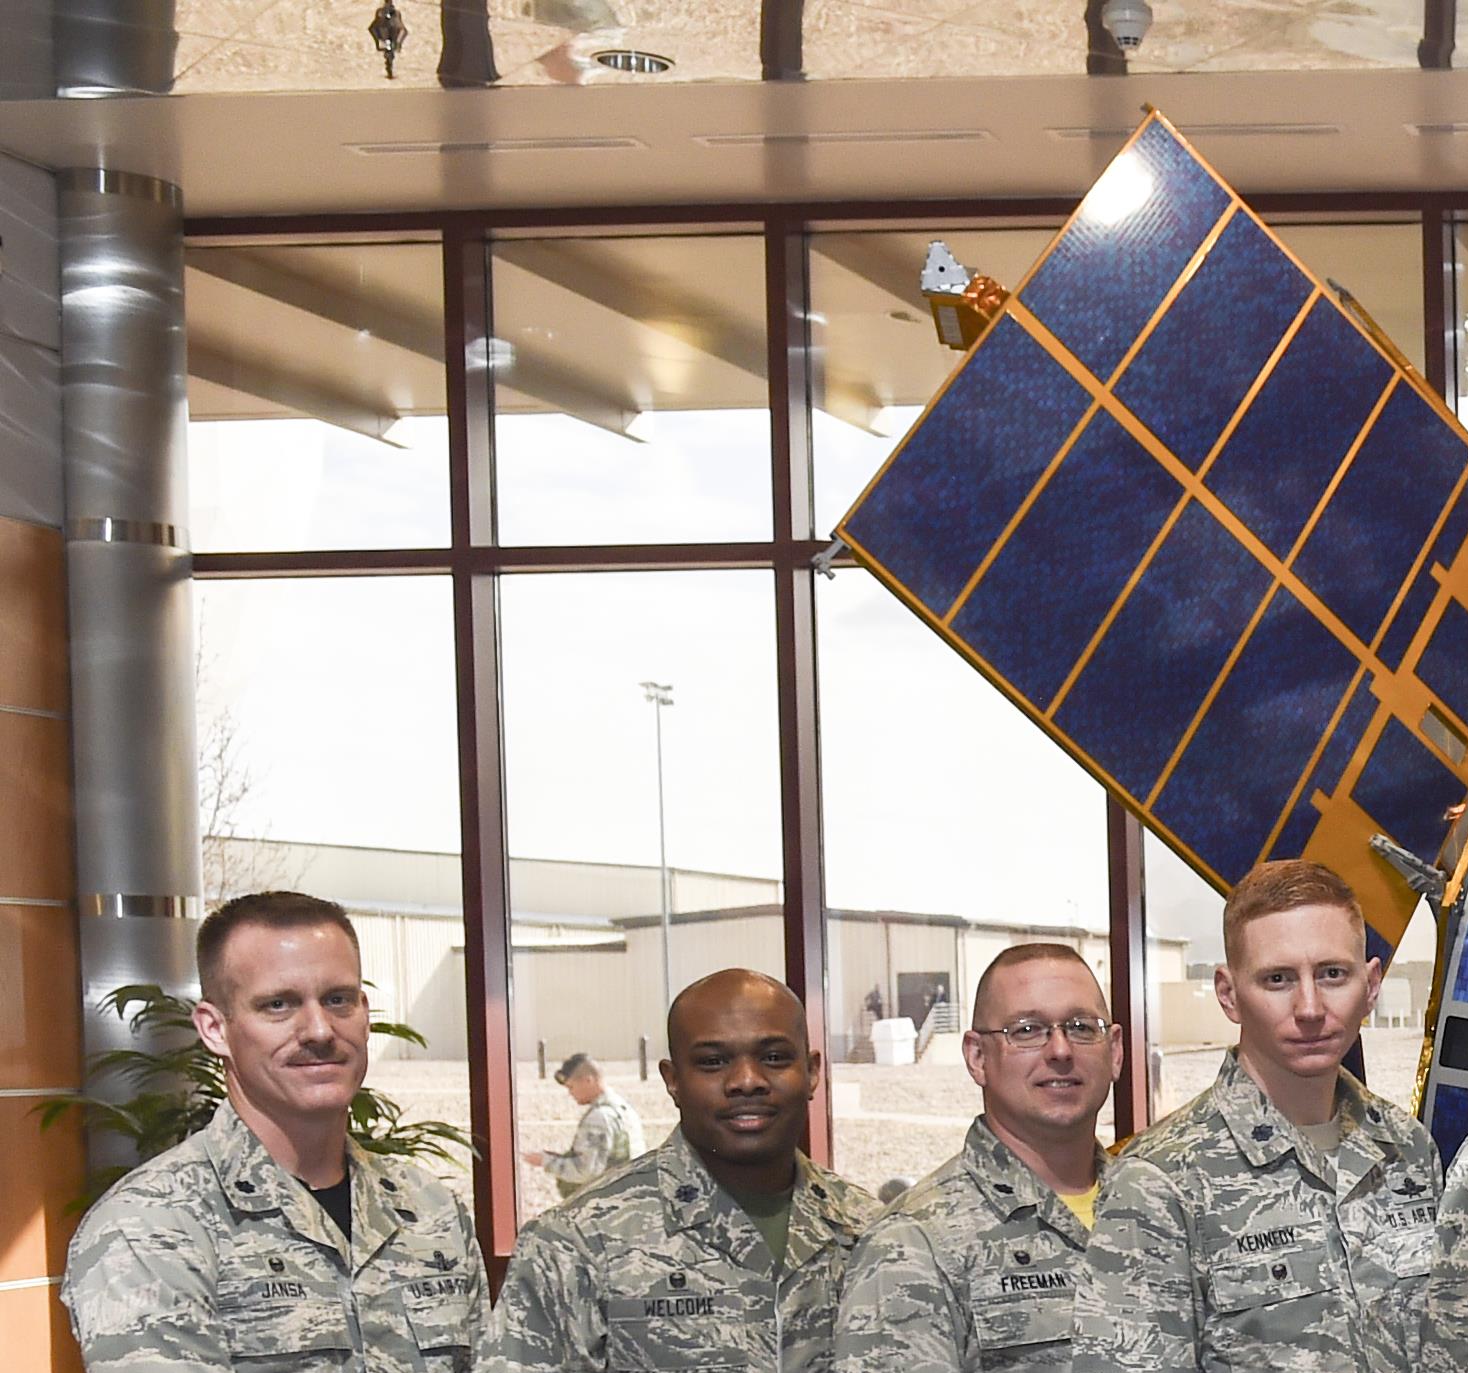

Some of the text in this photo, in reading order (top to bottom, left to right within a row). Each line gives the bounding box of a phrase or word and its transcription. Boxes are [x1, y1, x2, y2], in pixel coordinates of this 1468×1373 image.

[1236, 1226, 1295, 1254] KENNEDY
[262, 1282, 307, 1300] JANSA
[1001, 1272, 1066, 1293] FREEMAN
[644, 1298, 715, 1317] WELCOME
